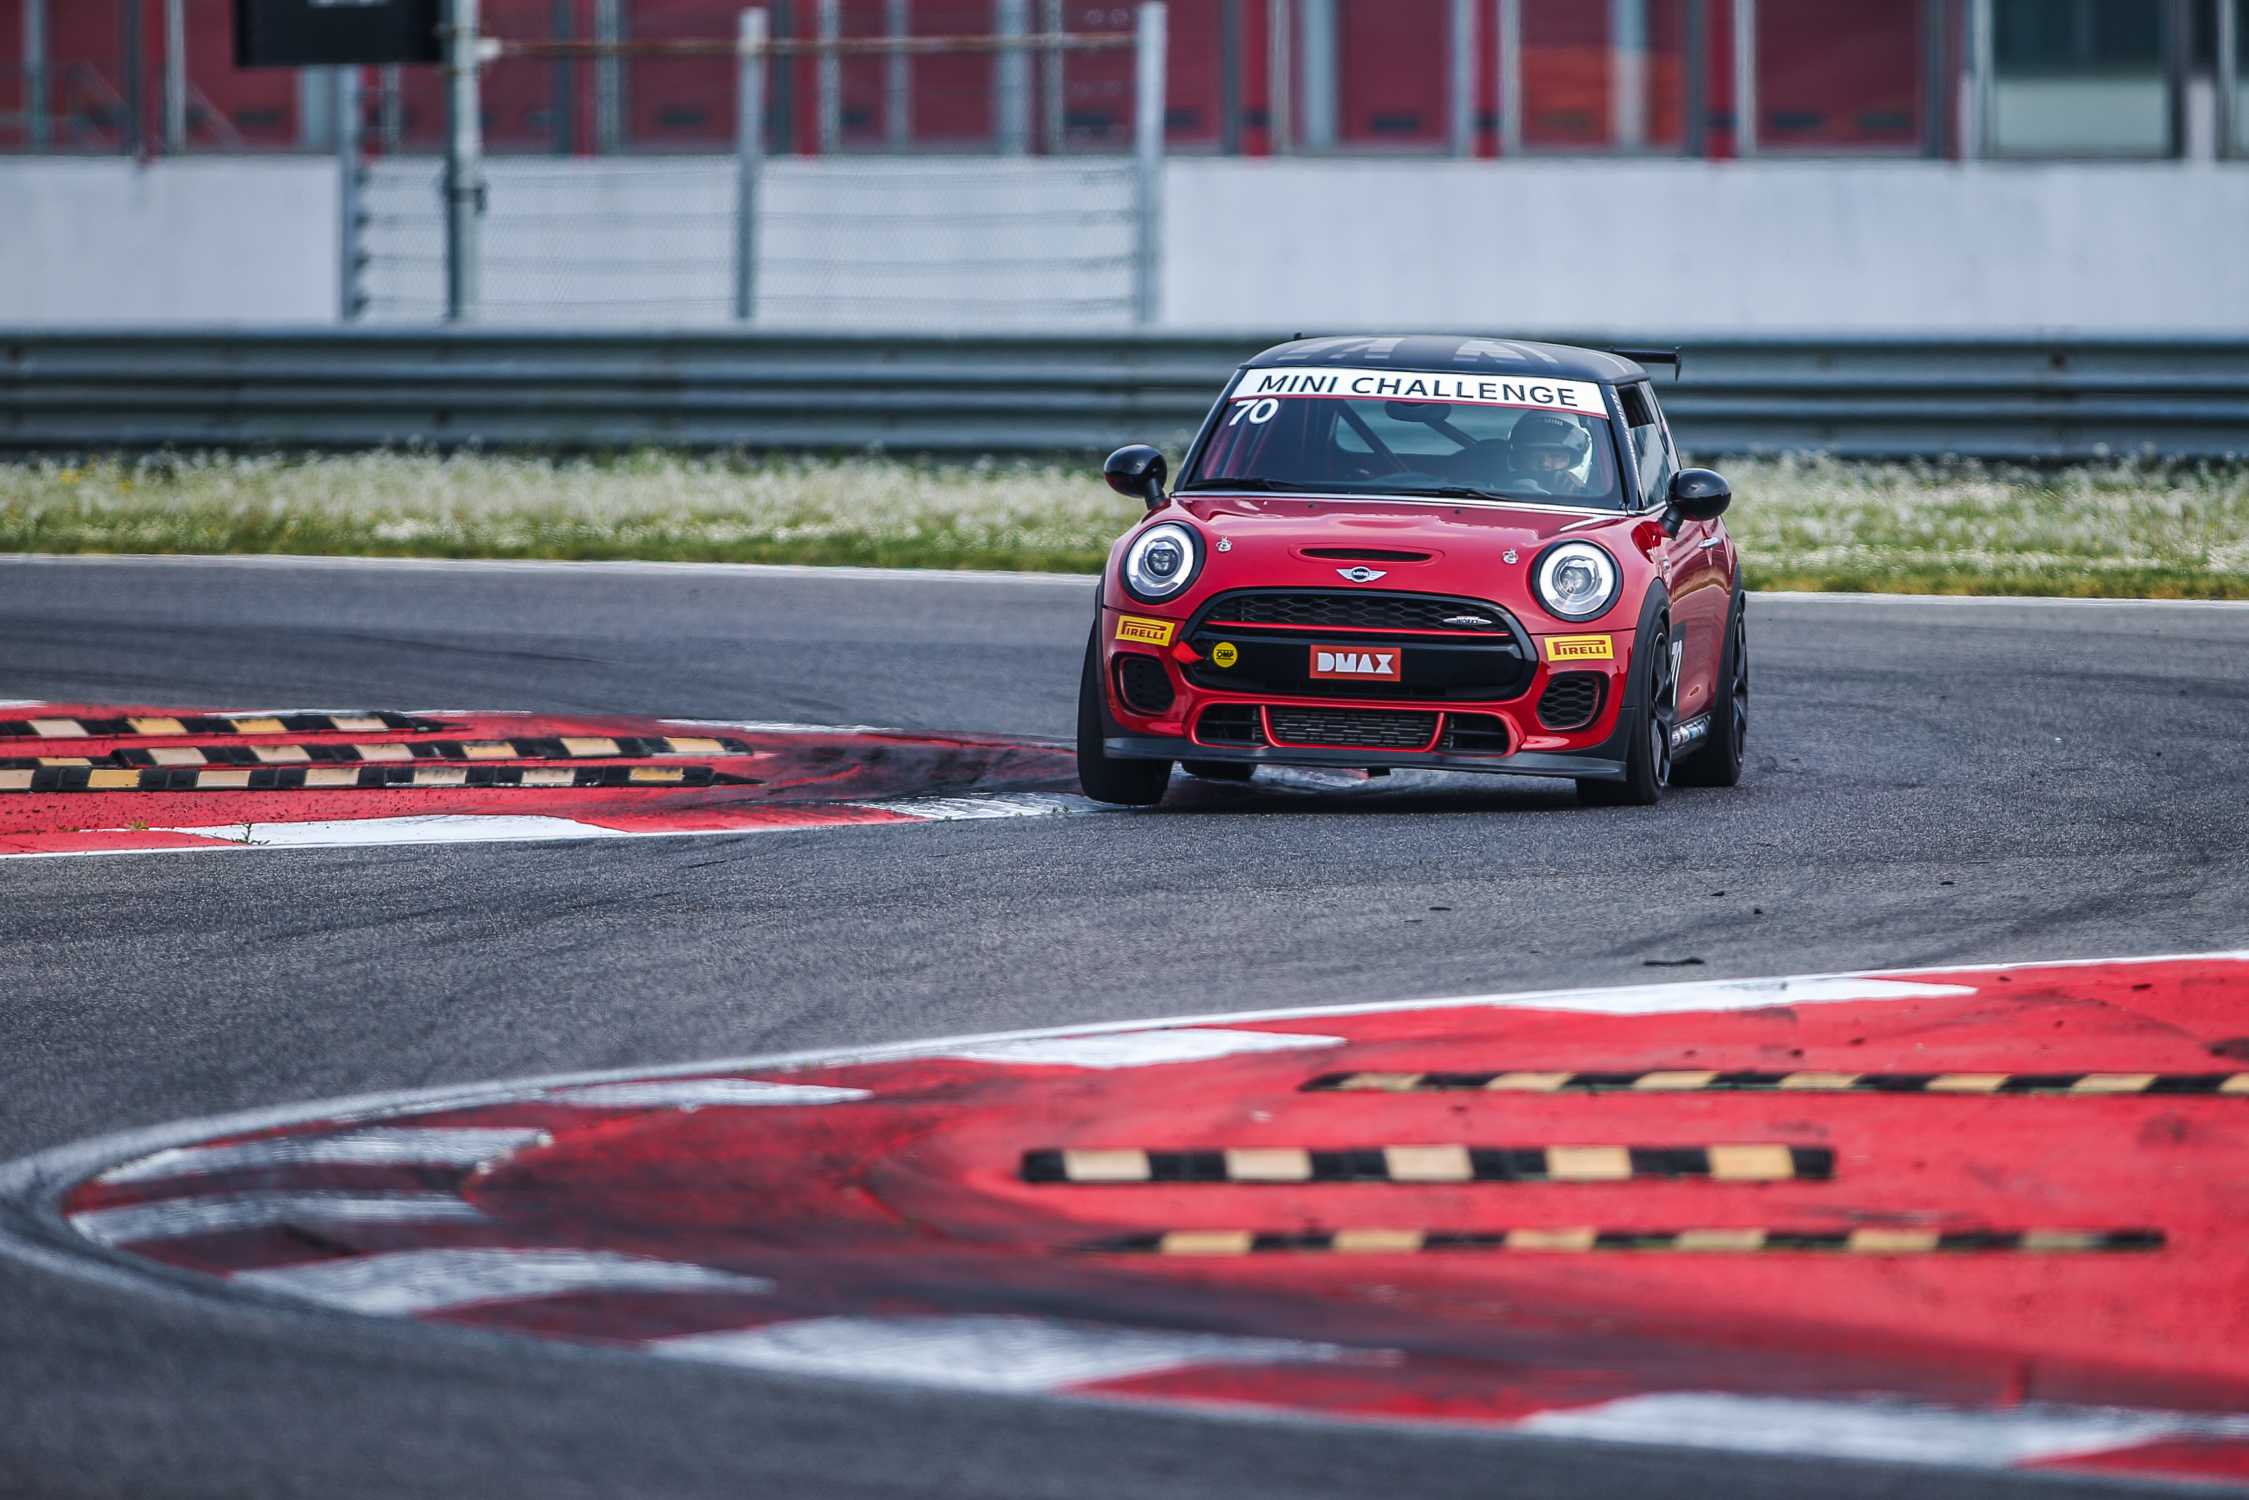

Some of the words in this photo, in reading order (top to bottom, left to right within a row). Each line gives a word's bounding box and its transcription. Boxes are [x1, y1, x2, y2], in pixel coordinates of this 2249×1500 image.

[1257, 375, 1338, 393] MINI
[1351, 377, 1578, 407] CHALLENGE
[1228, 397, 1279, 426] 70
[1121, 621, 1168, 640] PIRELLI
[1216, 650, 1234, 658] OMP
[1553, 639, 1607, 655] PIRELLI
[1317, 652, 1394, 674] DMAX
